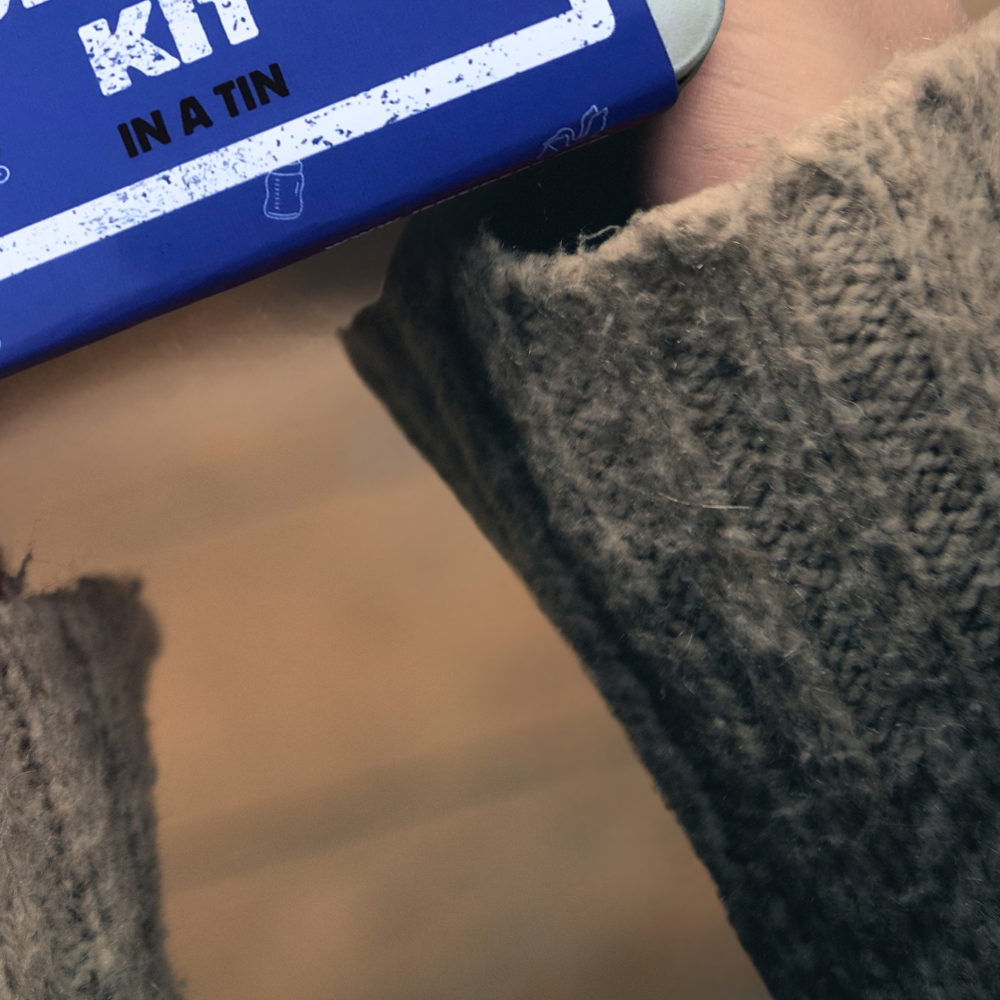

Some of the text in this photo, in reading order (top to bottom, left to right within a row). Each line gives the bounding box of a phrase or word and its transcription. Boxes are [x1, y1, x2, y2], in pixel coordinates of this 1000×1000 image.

[117, 63, 291, 158] IN A TIN
